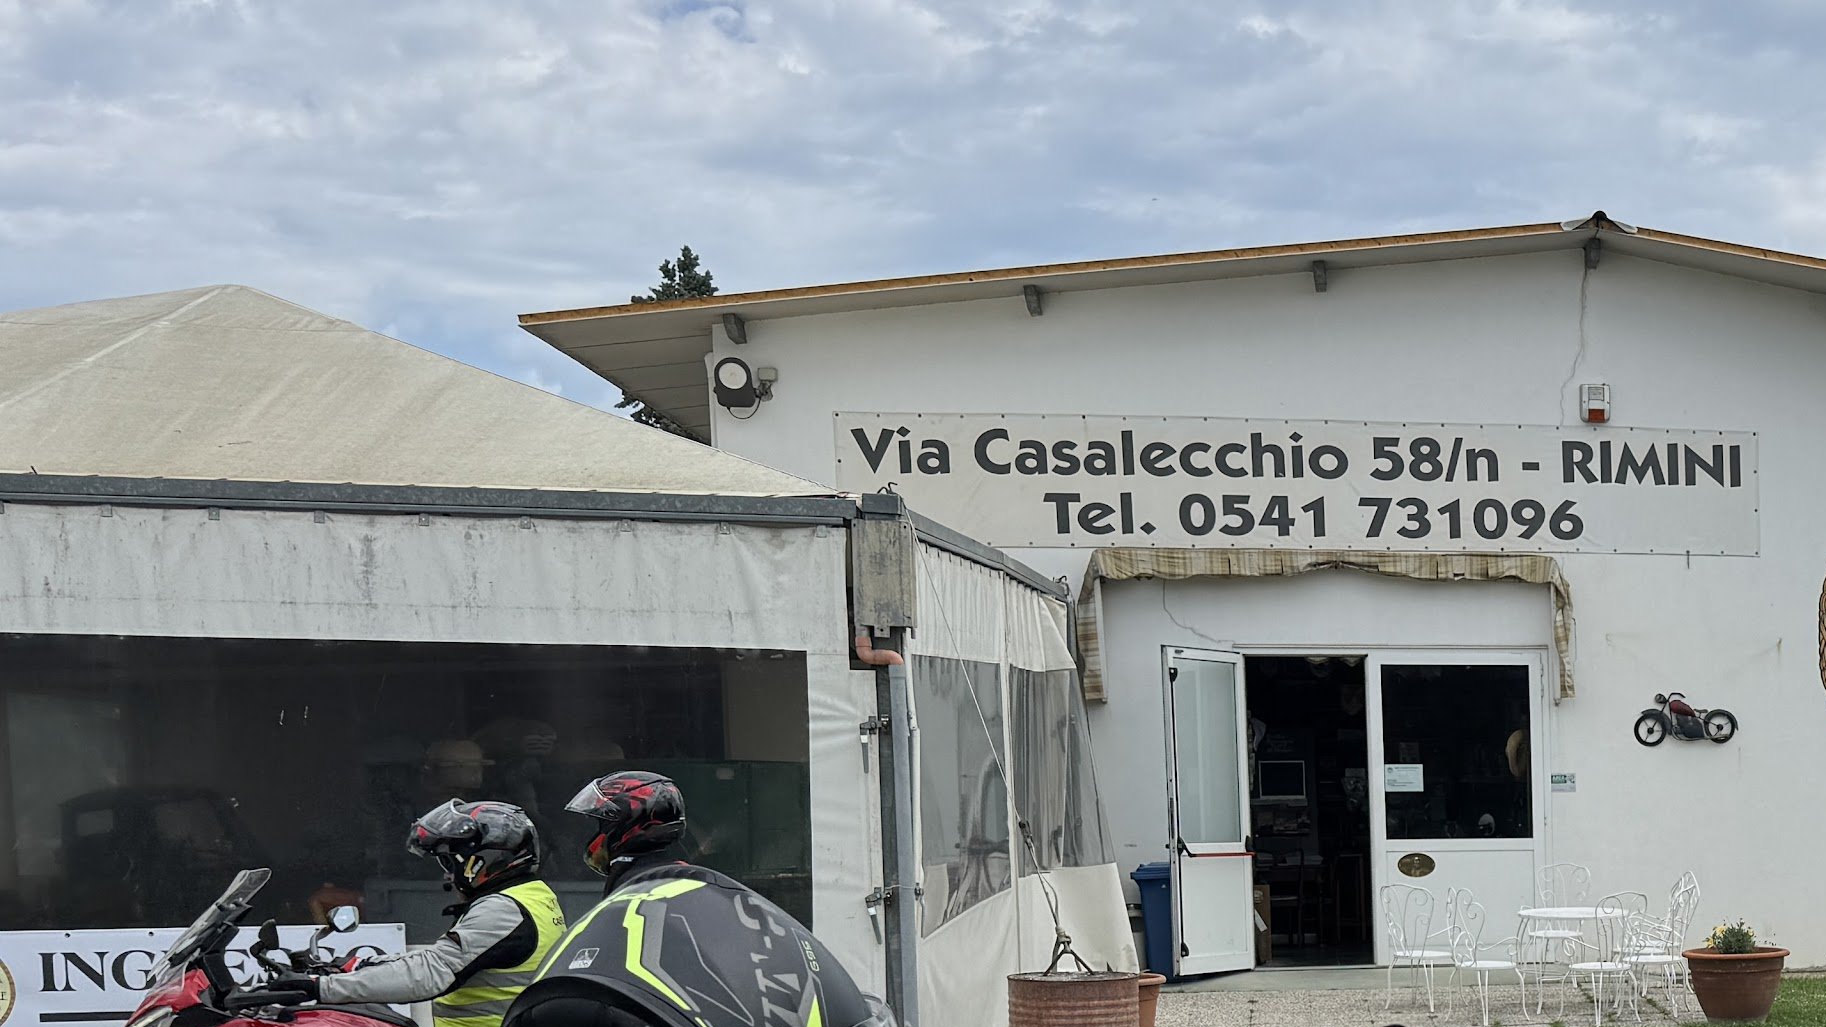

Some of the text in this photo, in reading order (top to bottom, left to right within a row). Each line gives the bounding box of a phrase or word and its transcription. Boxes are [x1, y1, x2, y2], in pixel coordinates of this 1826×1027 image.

[850, 427, 1743, 488] Via Casalecchio 58/n - RIMINI
[1043, 493, 1585, 541] Tel. 0541 731096
